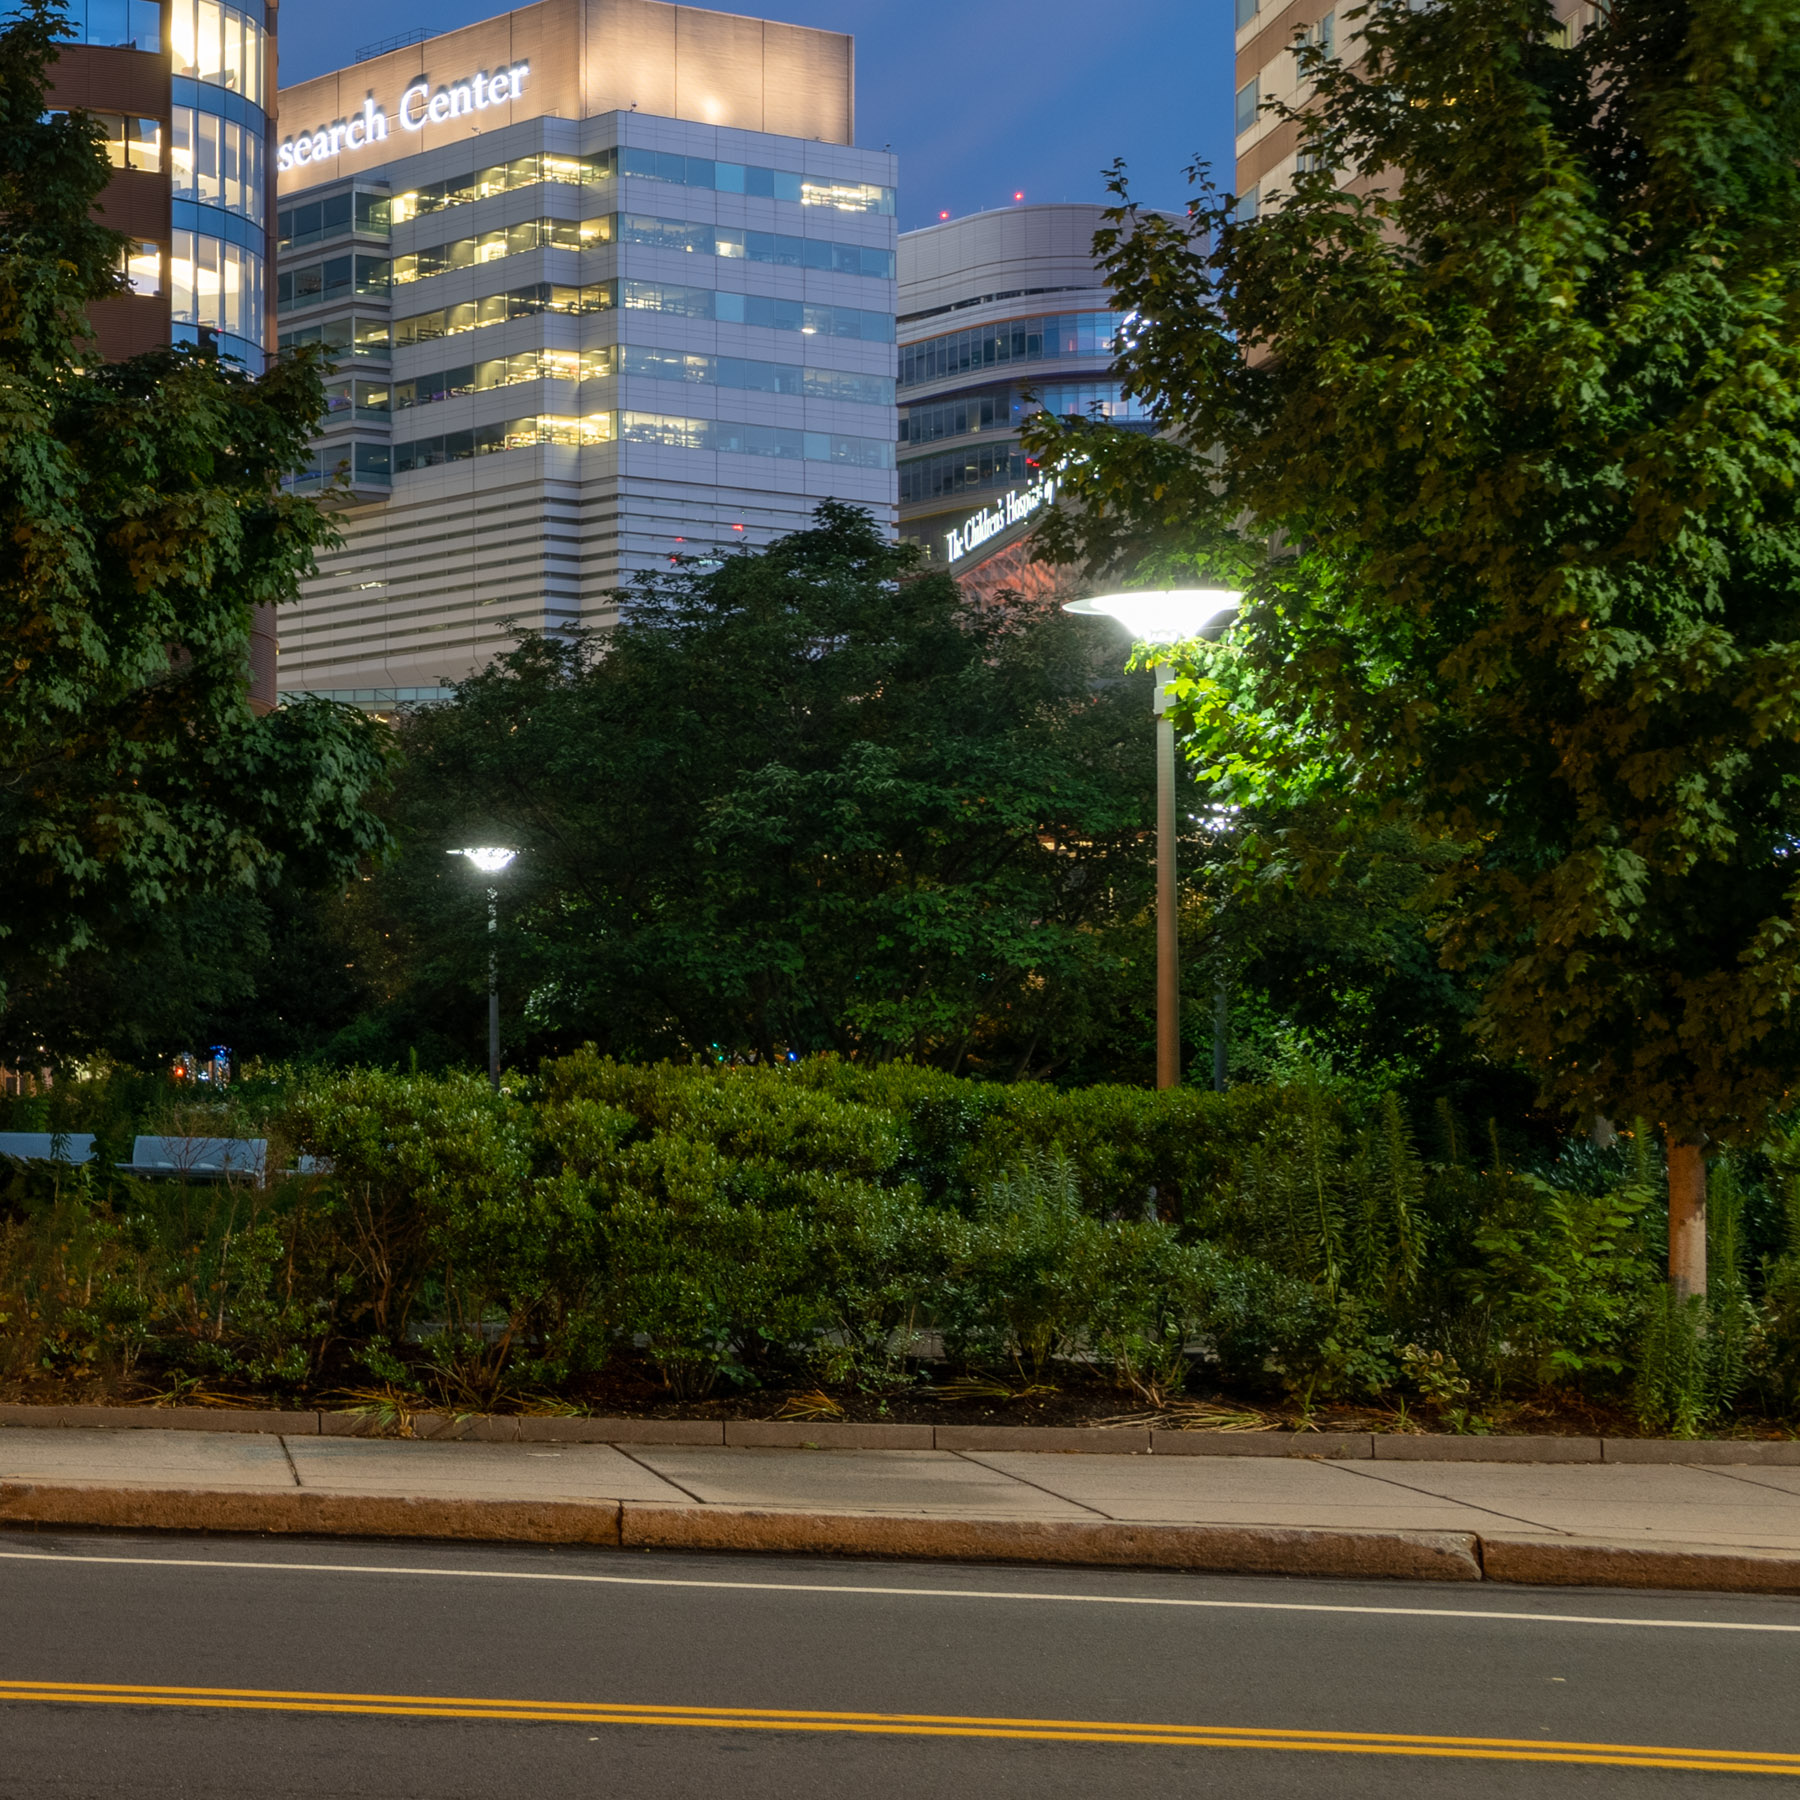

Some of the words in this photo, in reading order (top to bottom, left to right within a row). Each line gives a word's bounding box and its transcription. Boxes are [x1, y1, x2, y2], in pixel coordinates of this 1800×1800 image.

[276, 98, 388, 171] search
[399, 64, 531, 131] Center
[945, 528, 964, 562] The
[963, 498, 1006, 552] Children's
